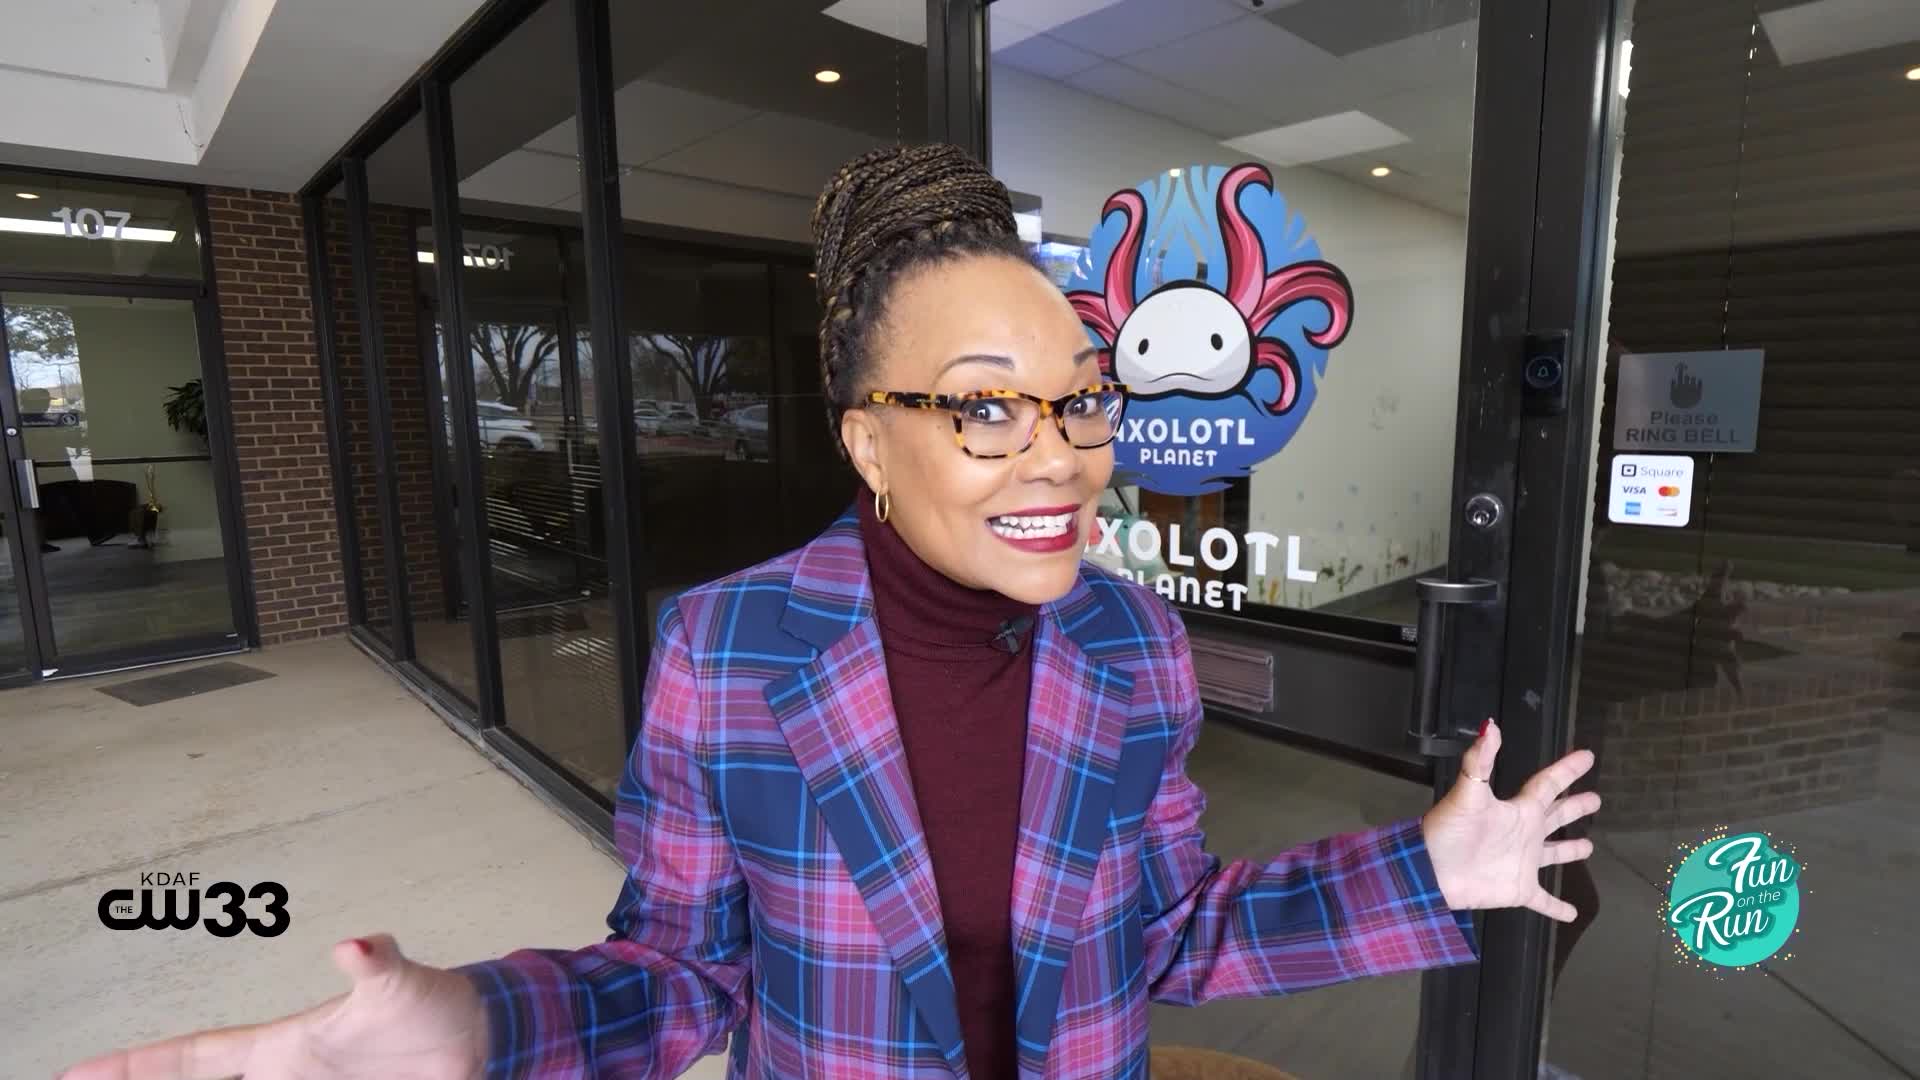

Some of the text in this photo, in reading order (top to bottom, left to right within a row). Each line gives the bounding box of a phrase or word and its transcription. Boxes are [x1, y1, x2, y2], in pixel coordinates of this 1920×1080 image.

[51, 206, 131, 240] 107
[1650, 411, 1719, 425] Please
[1626, 428, 1741, 444] RING BELL
[1140, 448, 1218, 467] PLANET
[1640, 465, 1684, 478] Square
[1622, 486, 1647, 495] VISA
[1084, 516, 1318, 583] XOLOTL
